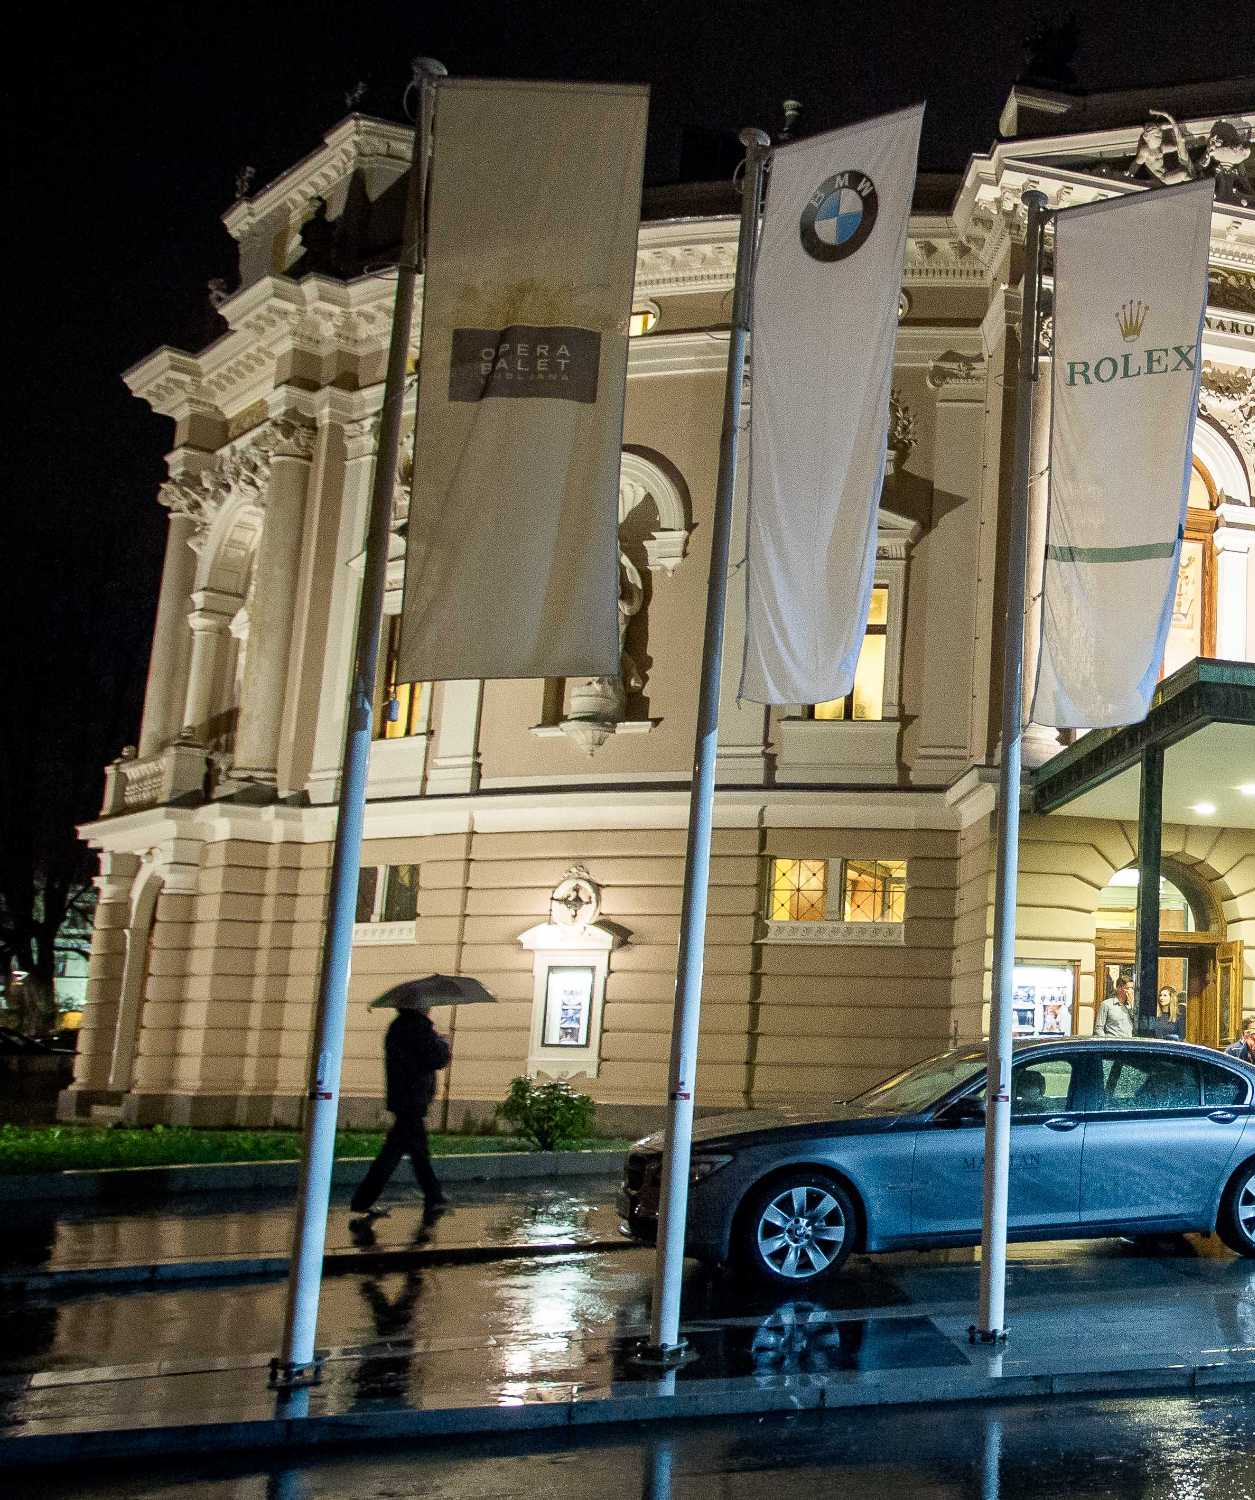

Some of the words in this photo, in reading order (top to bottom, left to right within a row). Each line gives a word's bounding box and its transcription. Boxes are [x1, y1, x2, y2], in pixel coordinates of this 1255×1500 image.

[808, 172, 875, 209] BMW
[480, 343, 571, 361] OPERA
[1065, 345, 1196, 386] ROLEX
[479, 358, 571, 376] BALET
